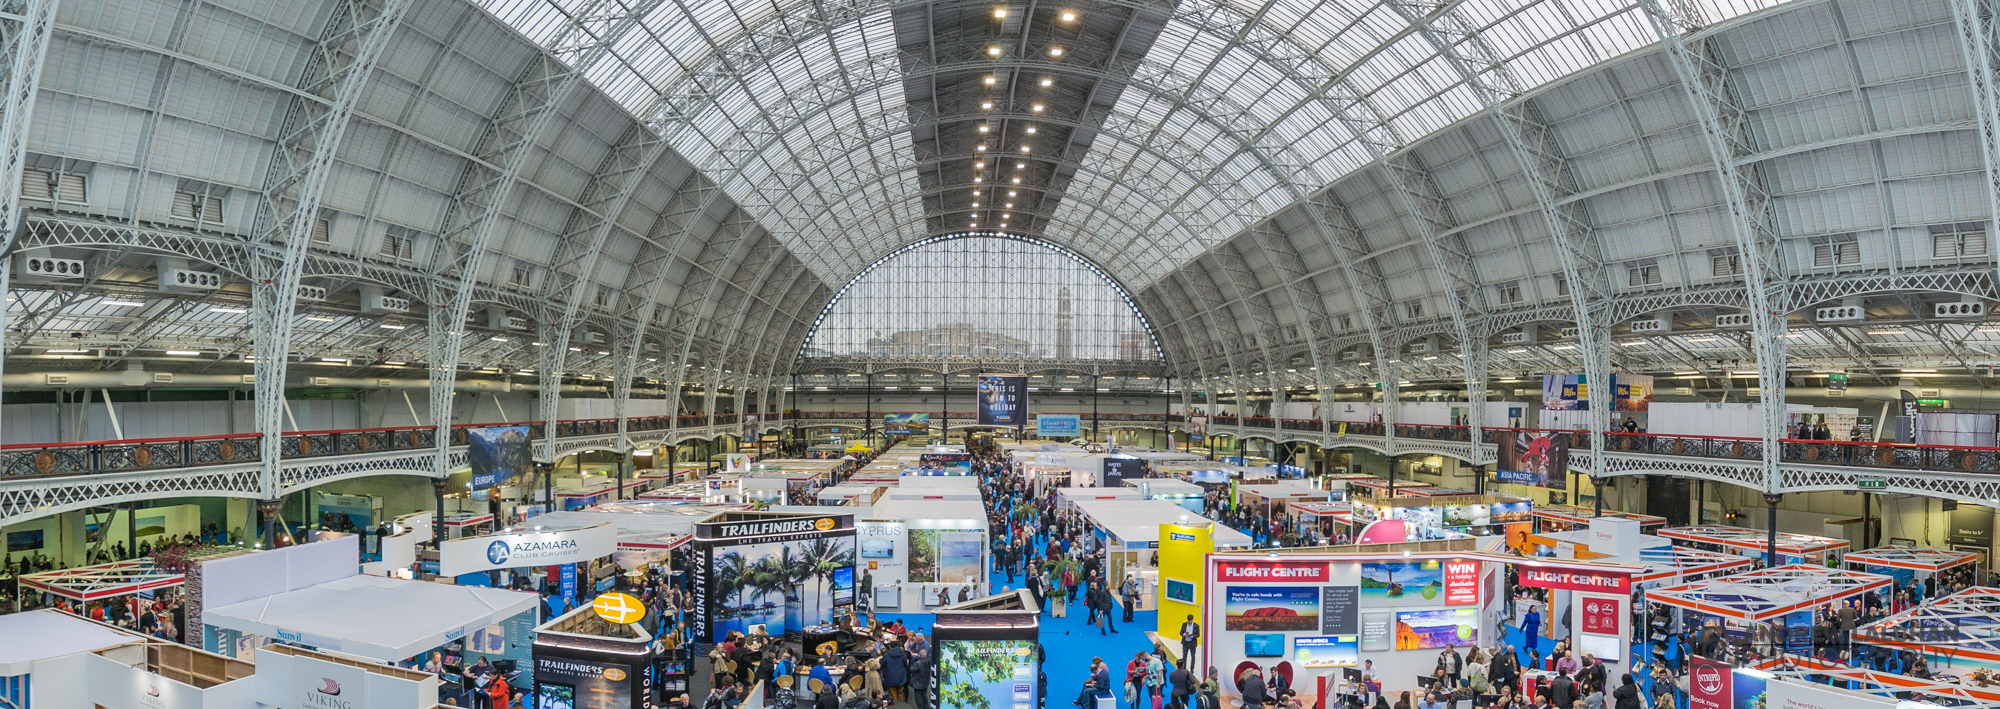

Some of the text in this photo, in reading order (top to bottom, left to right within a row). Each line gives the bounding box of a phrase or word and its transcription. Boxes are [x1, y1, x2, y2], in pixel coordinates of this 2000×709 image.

[475, 474, 495, 485] EUROPE
[1512, 472, 1532, 481] PACIFIC
[1431, 496, 1475, 507] Incredible
[721, 520, 814, 536] TRAILFINDERS
[855, 526, 901, 536] CYPRUS
[1596, 531, 1612, 539] Taiwan
[514, 540, 577, 551] AZAMARA
[1226, 567, 1320, 577] FLIGHT CENTRE
[1448, 564, 1474, 574] WIN
[1527, 571, 1619, 587] FLIGHT CENTRE
[696, 550, 705, 637] TRAILFINDERS
[277, 628, 302, 642] Sunvil
[446, 626, 465, 639] Sunvil
[540, 660, 603, 674] TRAILFINDERS
[1697, 674, 1721, 682] INTREPID
[142, 694, 165, 708] VIKING
[307, 692, 350, 709] VIKING
[1691, 695, 1706, 704] Book
